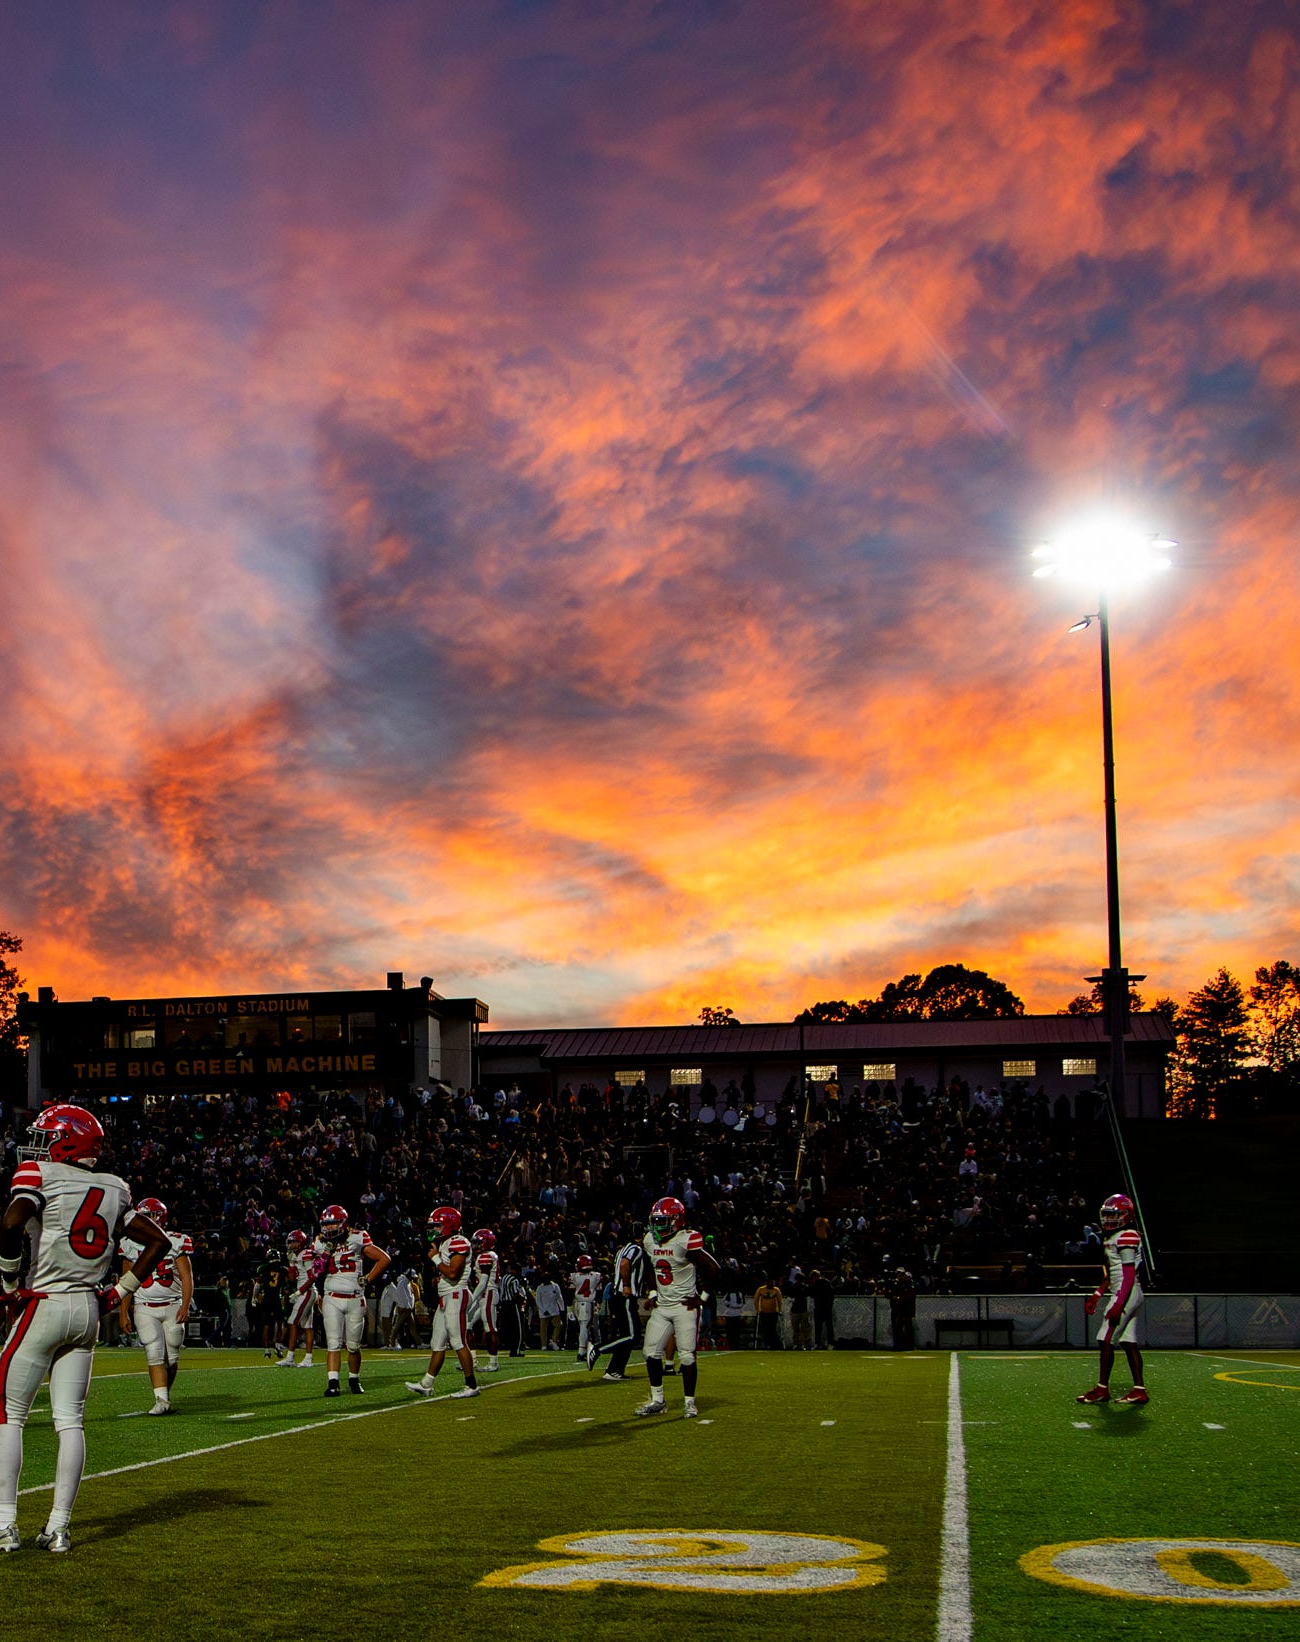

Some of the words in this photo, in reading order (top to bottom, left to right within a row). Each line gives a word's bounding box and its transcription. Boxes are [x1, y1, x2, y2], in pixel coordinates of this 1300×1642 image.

[165, 1002, 228, 1016] DALTON
[237, 999, 310, 1013] STADIUM
[73, 1061, 117, 1079] THE
[127, 1060, 166, 1078] BIG
[175, 1057, 254, 1077] GREEN
[266, 1054, 376, 1073] MACHINE
[69, 1186, 109, 1260] 6
[653, 1248, 674, 1257] ERWIN
[656, 1259, 673, 1286] 3
[577, 1278, 591, 1298] 4
